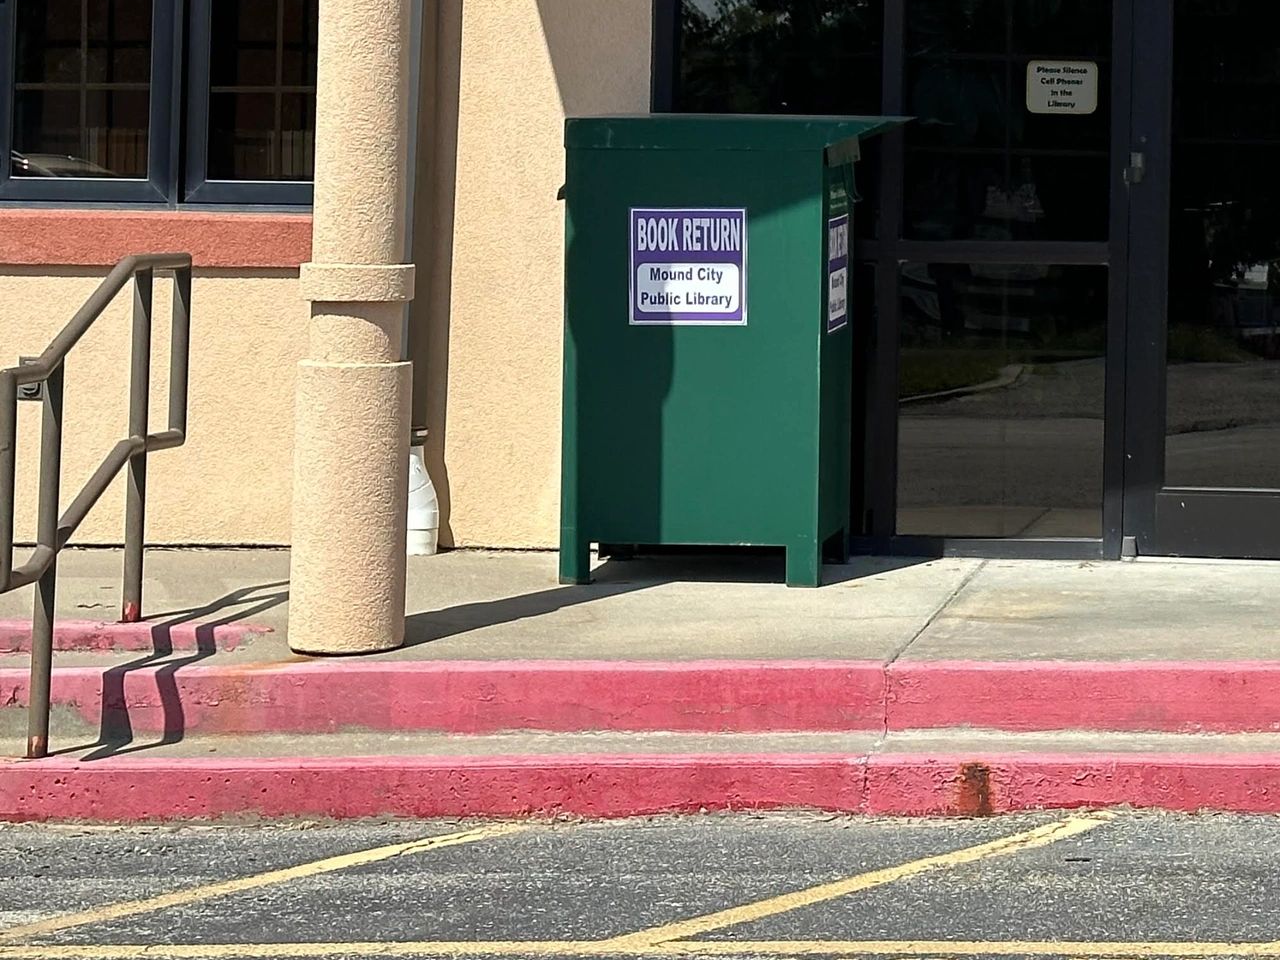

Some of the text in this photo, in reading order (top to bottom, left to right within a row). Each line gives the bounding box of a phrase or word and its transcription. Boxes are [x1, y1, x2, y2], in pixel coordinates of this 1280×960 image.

[1036, 66, 1088, 74] Please Silence
[1040, 77, 1083, 85] Cell Phones
[1047, 100, 1076, 109] Library
[637, 218, 740, 252] BOOK RETURN
[650, 266, 723, 284] Mound City
[641, 292, 732, 308] Public Library
